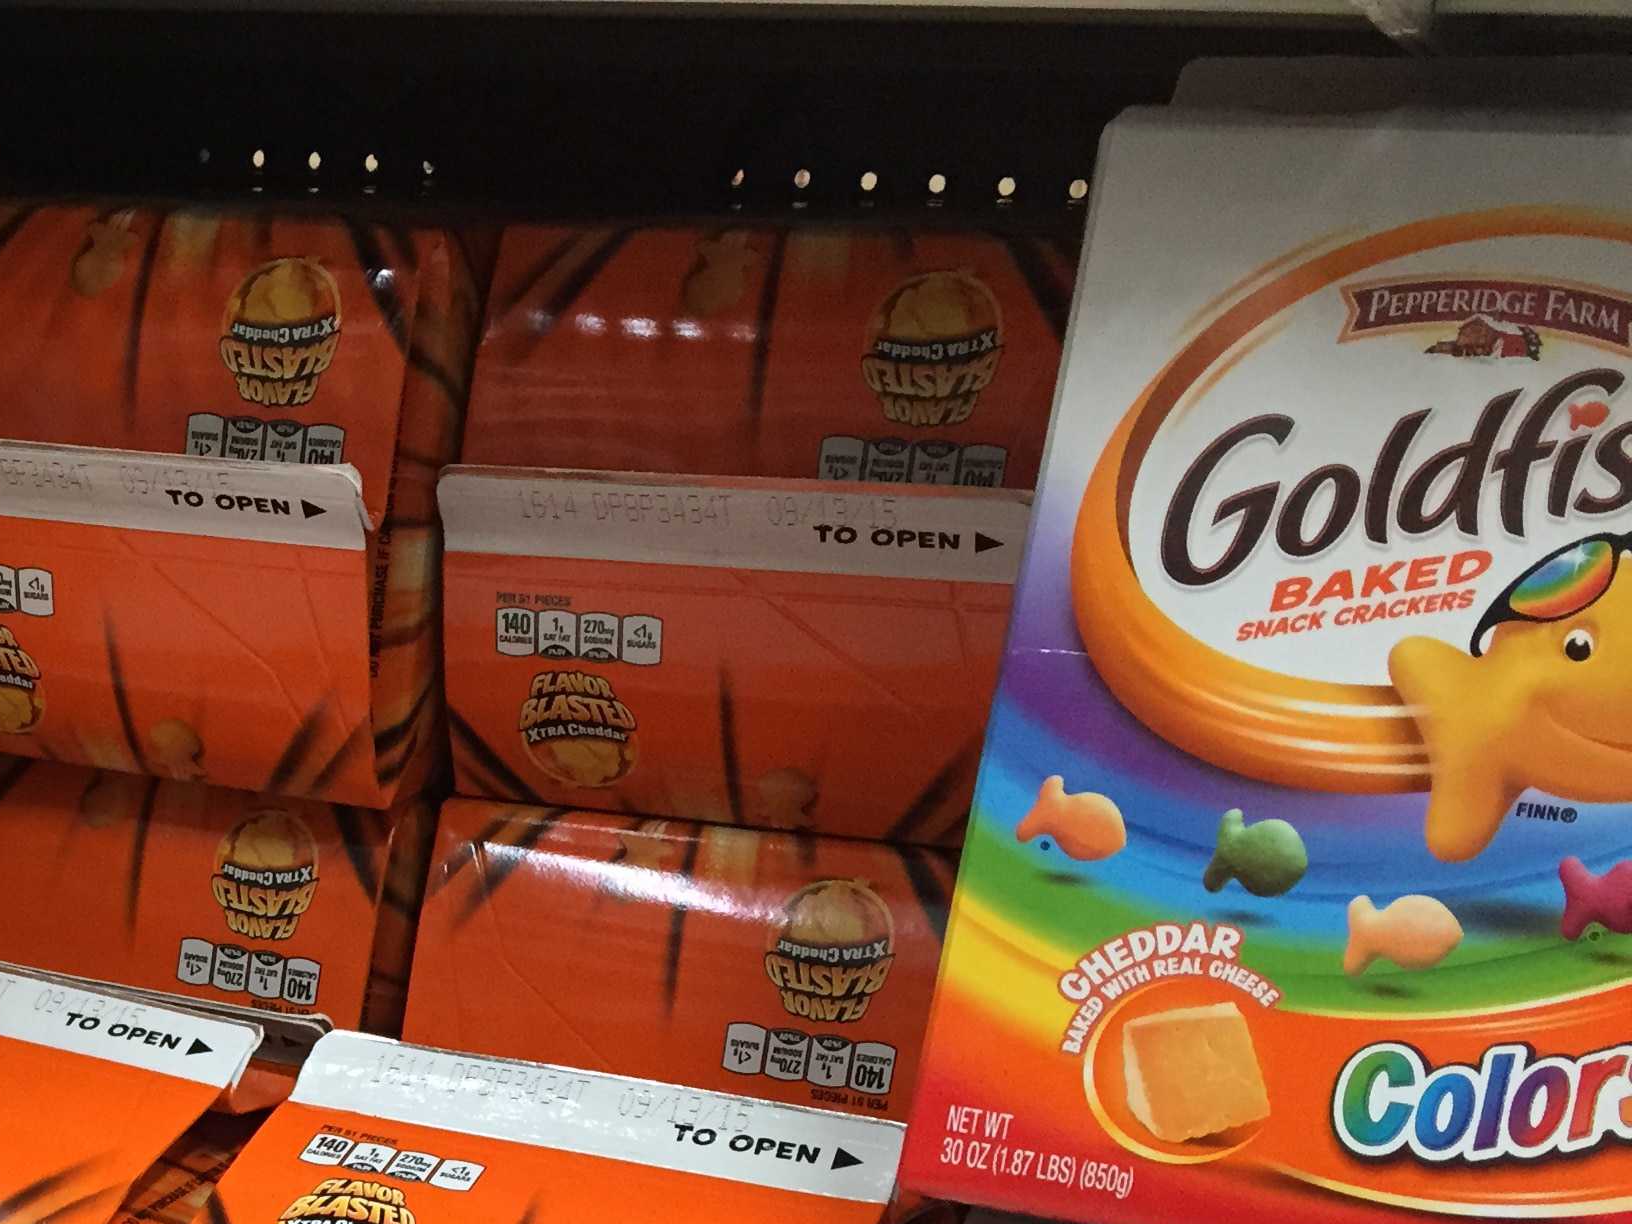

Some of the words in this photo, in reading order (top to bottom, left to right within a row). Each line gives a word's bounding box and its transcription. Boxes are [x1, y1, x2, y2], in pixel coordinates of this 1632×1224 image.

[1368, 287, 1537, 323] PEPPERIDGE
[1544, 291, 1622, 335] FARM
[165, 490, 204, 507] TO
[215, 495, 290, 517] OPEN
[813, 524, 858, 544] TO
[871, 528, 961, 550] OPEN
[1269, 549, 1494, 615] BAKED
[502, 613, 531, 635] 140
[1236, 611, 1325, 642] SNACK
[1334, 589, 1476, 628] CRACKERS
[531, 672, 616, 698] FLAVOR
[521, 694, 637, 730] BLASTED
[528, 724, 565, 743] XTRA
[567, 723, 628, 742] Cheddar
[223, 863, 273, 885] Cheddar
[276, 865, 313, 885] XTRA
[211, 876, 318, 917] BLASTED
[226, 911, 300, 940] FLAVOR
[778, 940, 840, 963] Cheddar
[842, 940, 889, 961] XTRA
[1060, 923, 1241, 1001] CHEDDAR
[287, 979, 312, 1001] 140
[765, 953, 895, 998] BLASTED
[782, 991, 871, 1022] FLAVOR
[1062, 996, 1104, 1054] BAKED
[1100, 964, 1151, 1001] WITH
[1153, 957, 1204, 978] REAL
[1208, 960, 1280, 1008] CHEESE
[65, 1012, 101, 1031] TO
[107, 1023, 183, 1050] OPEN
[854, 1064, 886, 1089] 140
[1332, 1040, 1632, 1165] Color
[946, 1104, 981, 1135] NET
[983, 1112, 1014, 1140] WT
[316, 1136, 348, 1152] 140
[360, 1132, 399, 1145] PIECES
[674, 1123, 717, 1146] TO
[729, 1133, 821, 1164] OPEN
[940, 1138, 966, 1164] 30
[967, 1144, 991, 1171] OZ
[992, 1148, 1033, 1180] (1.87
[1036, 1155, 1078, 1189] LBS)
[1079, 1161, 1134, 1200] (850g)
[312, 1178, 406, 1206] FLAVOR
